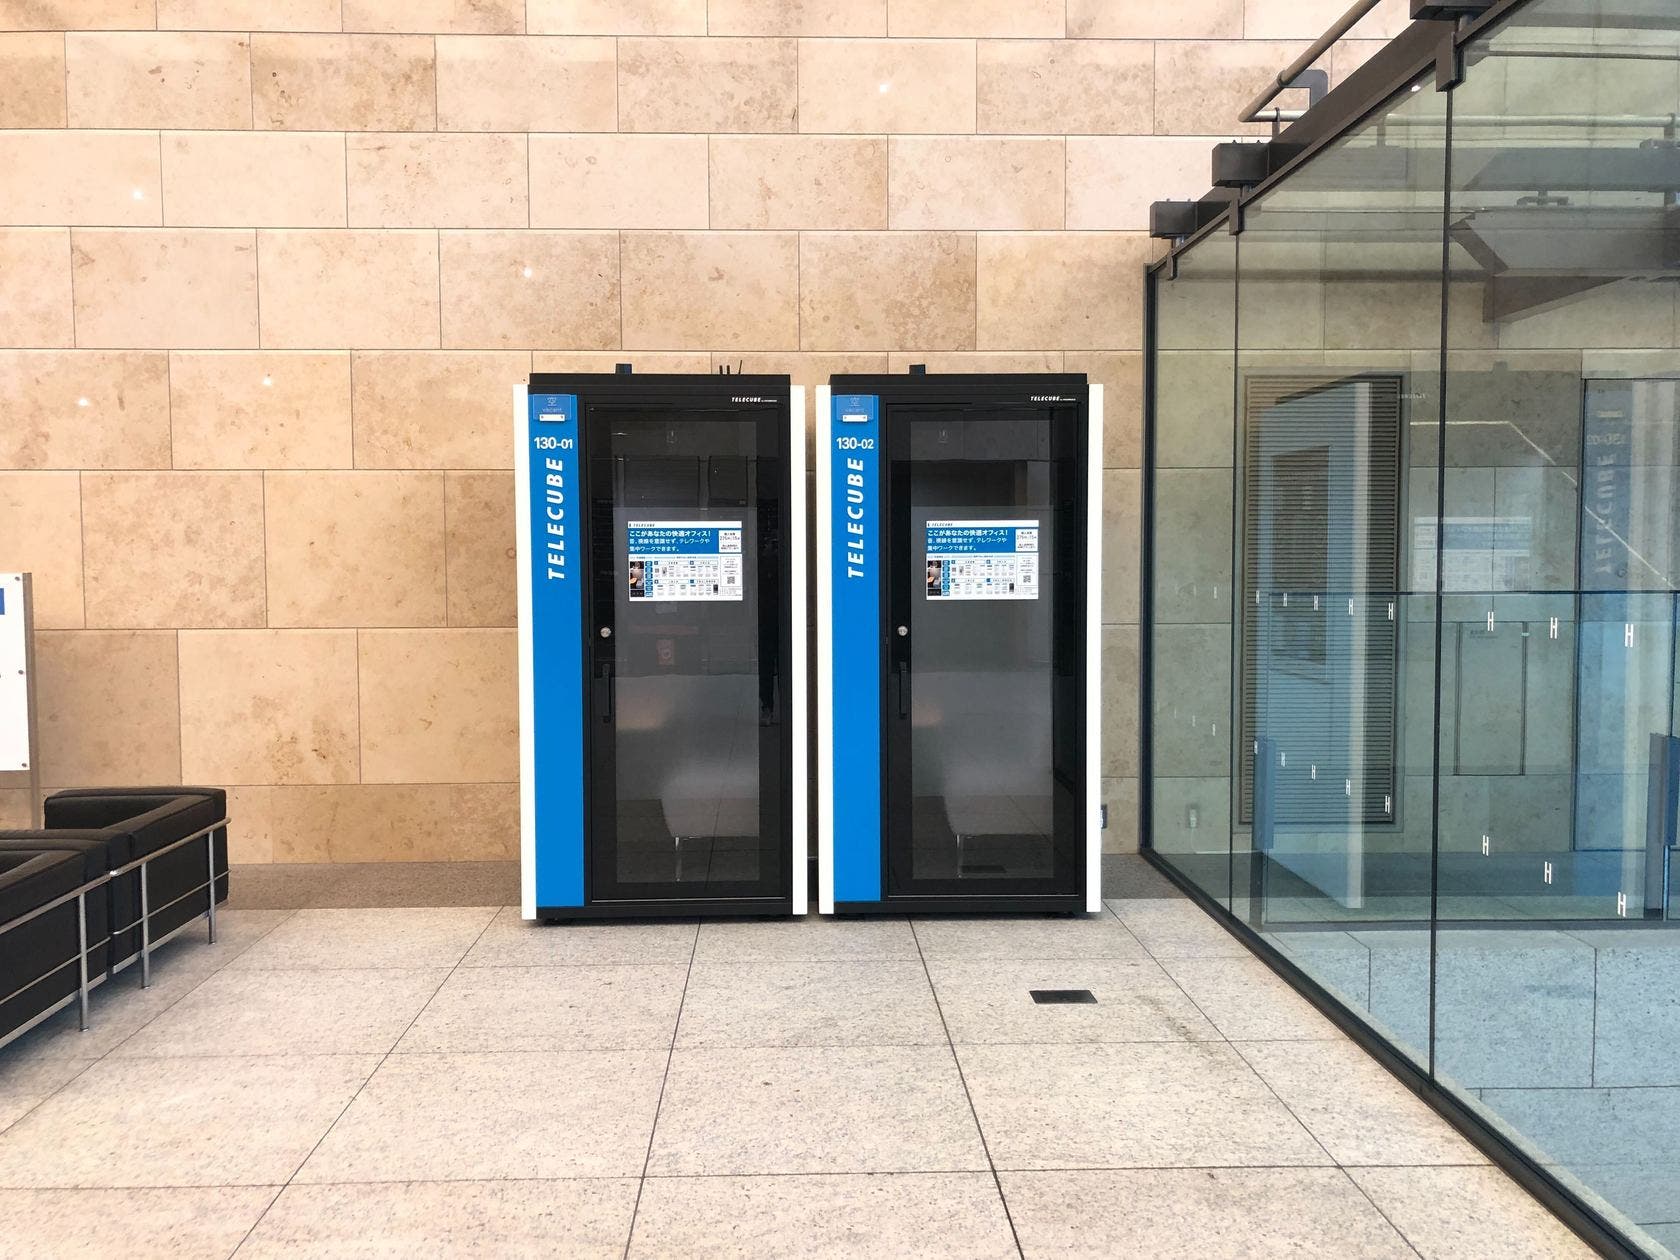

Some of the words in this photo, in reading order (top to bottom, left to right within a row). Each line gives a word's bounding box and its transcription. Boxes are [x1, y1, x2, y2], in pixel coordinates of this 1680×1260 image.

[533, 436, 573, 450] 130-01
[836, 436, 874, 450] 130-02
[546, 457, 565, 580] TELECUBE
[847, 457, 864, 578] TELECUBE
